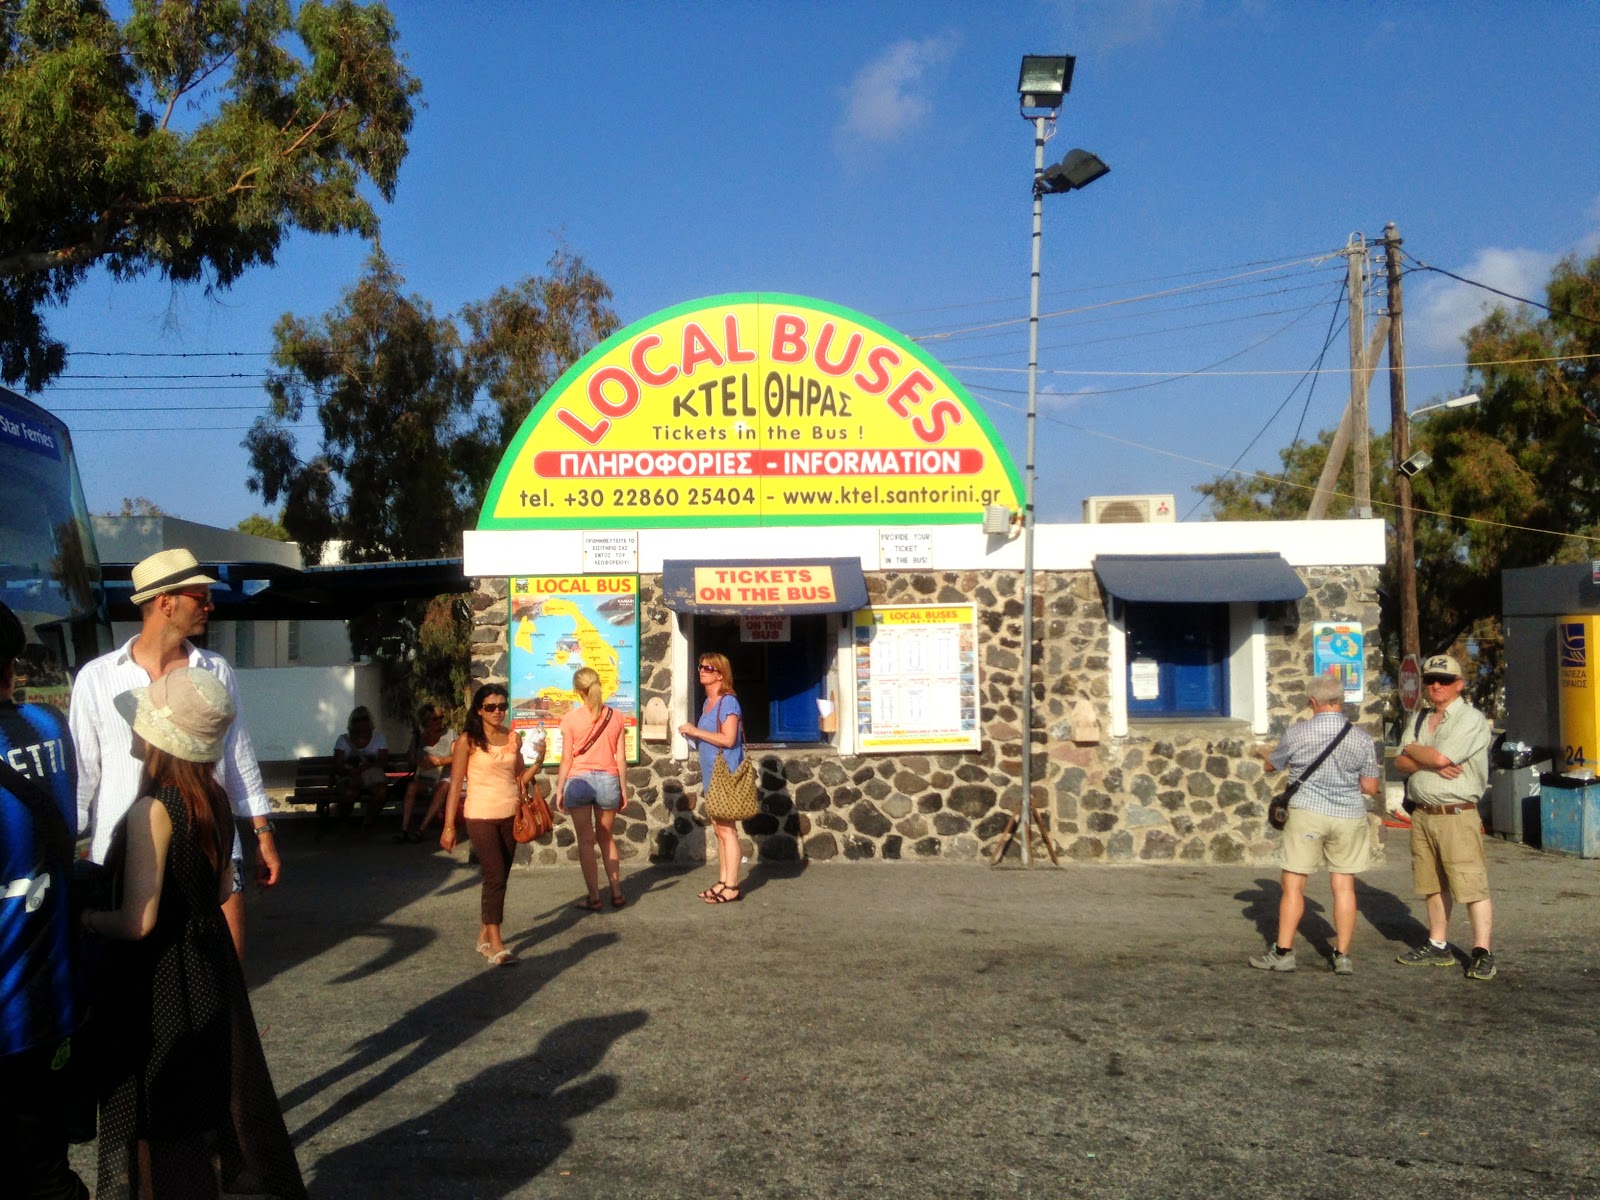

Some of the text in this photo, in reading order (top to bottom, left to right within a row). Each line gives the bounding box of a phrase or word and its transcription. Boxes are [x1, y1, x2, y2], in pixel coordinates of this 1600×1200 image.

[555, 312, 964, 446] LOCAL BUSES
[672, 370, 852, 418] KTEL ΘΗΡΑΣ
[21, 423, 54, 449] Ferries
[652, 425, 727, 440] Tickets
[738, 424, 756, 440] in
[768, 425, 801, 440] the
[812, 425, 848, 440] Bus
[560, 451, 753, 476] ΠΛΗΡΟΦΟΡΙΕΣ
[783, 450, 961, 475] INFORMATION
[520, 488, 555, 507] tel.
[564, 488, 604, 507] +30
[612, 488, 680, 507] 22860
[687, 487, 755, 506] 25404
[783, 485, 1001, 507] www.ktel.santorini.gr
[880, 533, 931, 541] PROVIDE YOUR
[715, 569, 812, 584] TICKETS
[536, 578, 632, 593] LOCAL BUS
[700, 585, 831, 601] ON THE BUS
[889, 610, 958, 620] LOCAL BUSES
[746, 620, 783, 630] ON THE
[751, 630, 780, 640] BUS
[0, 738, 66, 780] ETTI
[1566, 744, 1585, 767] 24
